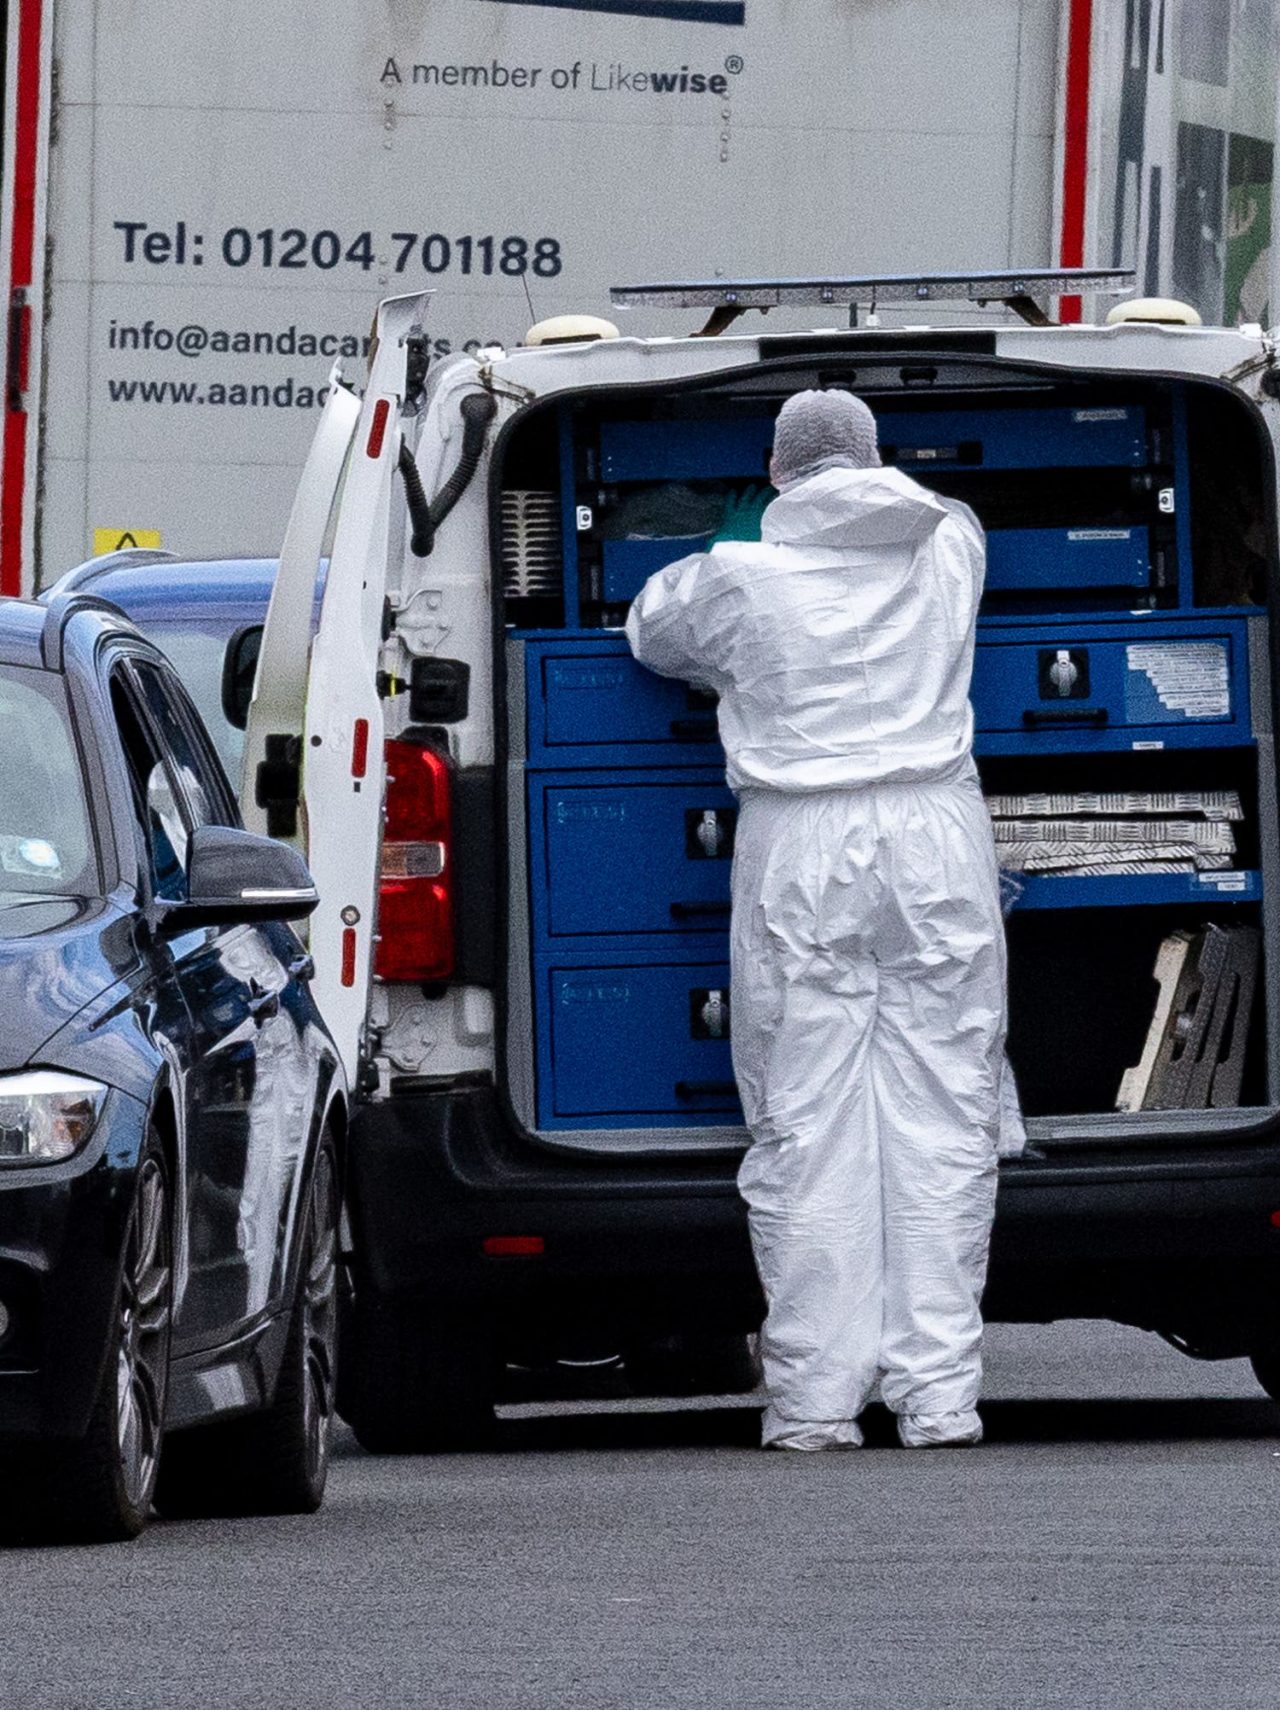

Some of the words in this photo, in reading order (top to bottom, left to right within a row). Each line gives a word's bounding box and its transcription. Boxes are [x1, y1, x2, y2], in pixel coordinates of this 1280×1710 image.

[380, 57, 401, 83] A
[412, 60, 541, 88] member
[551, 61, 581, 89] of
[114, 221, 202, 266] Tel:
[223, 227, 375, 270] 01204
[391, 233, 562, 278] 701188
